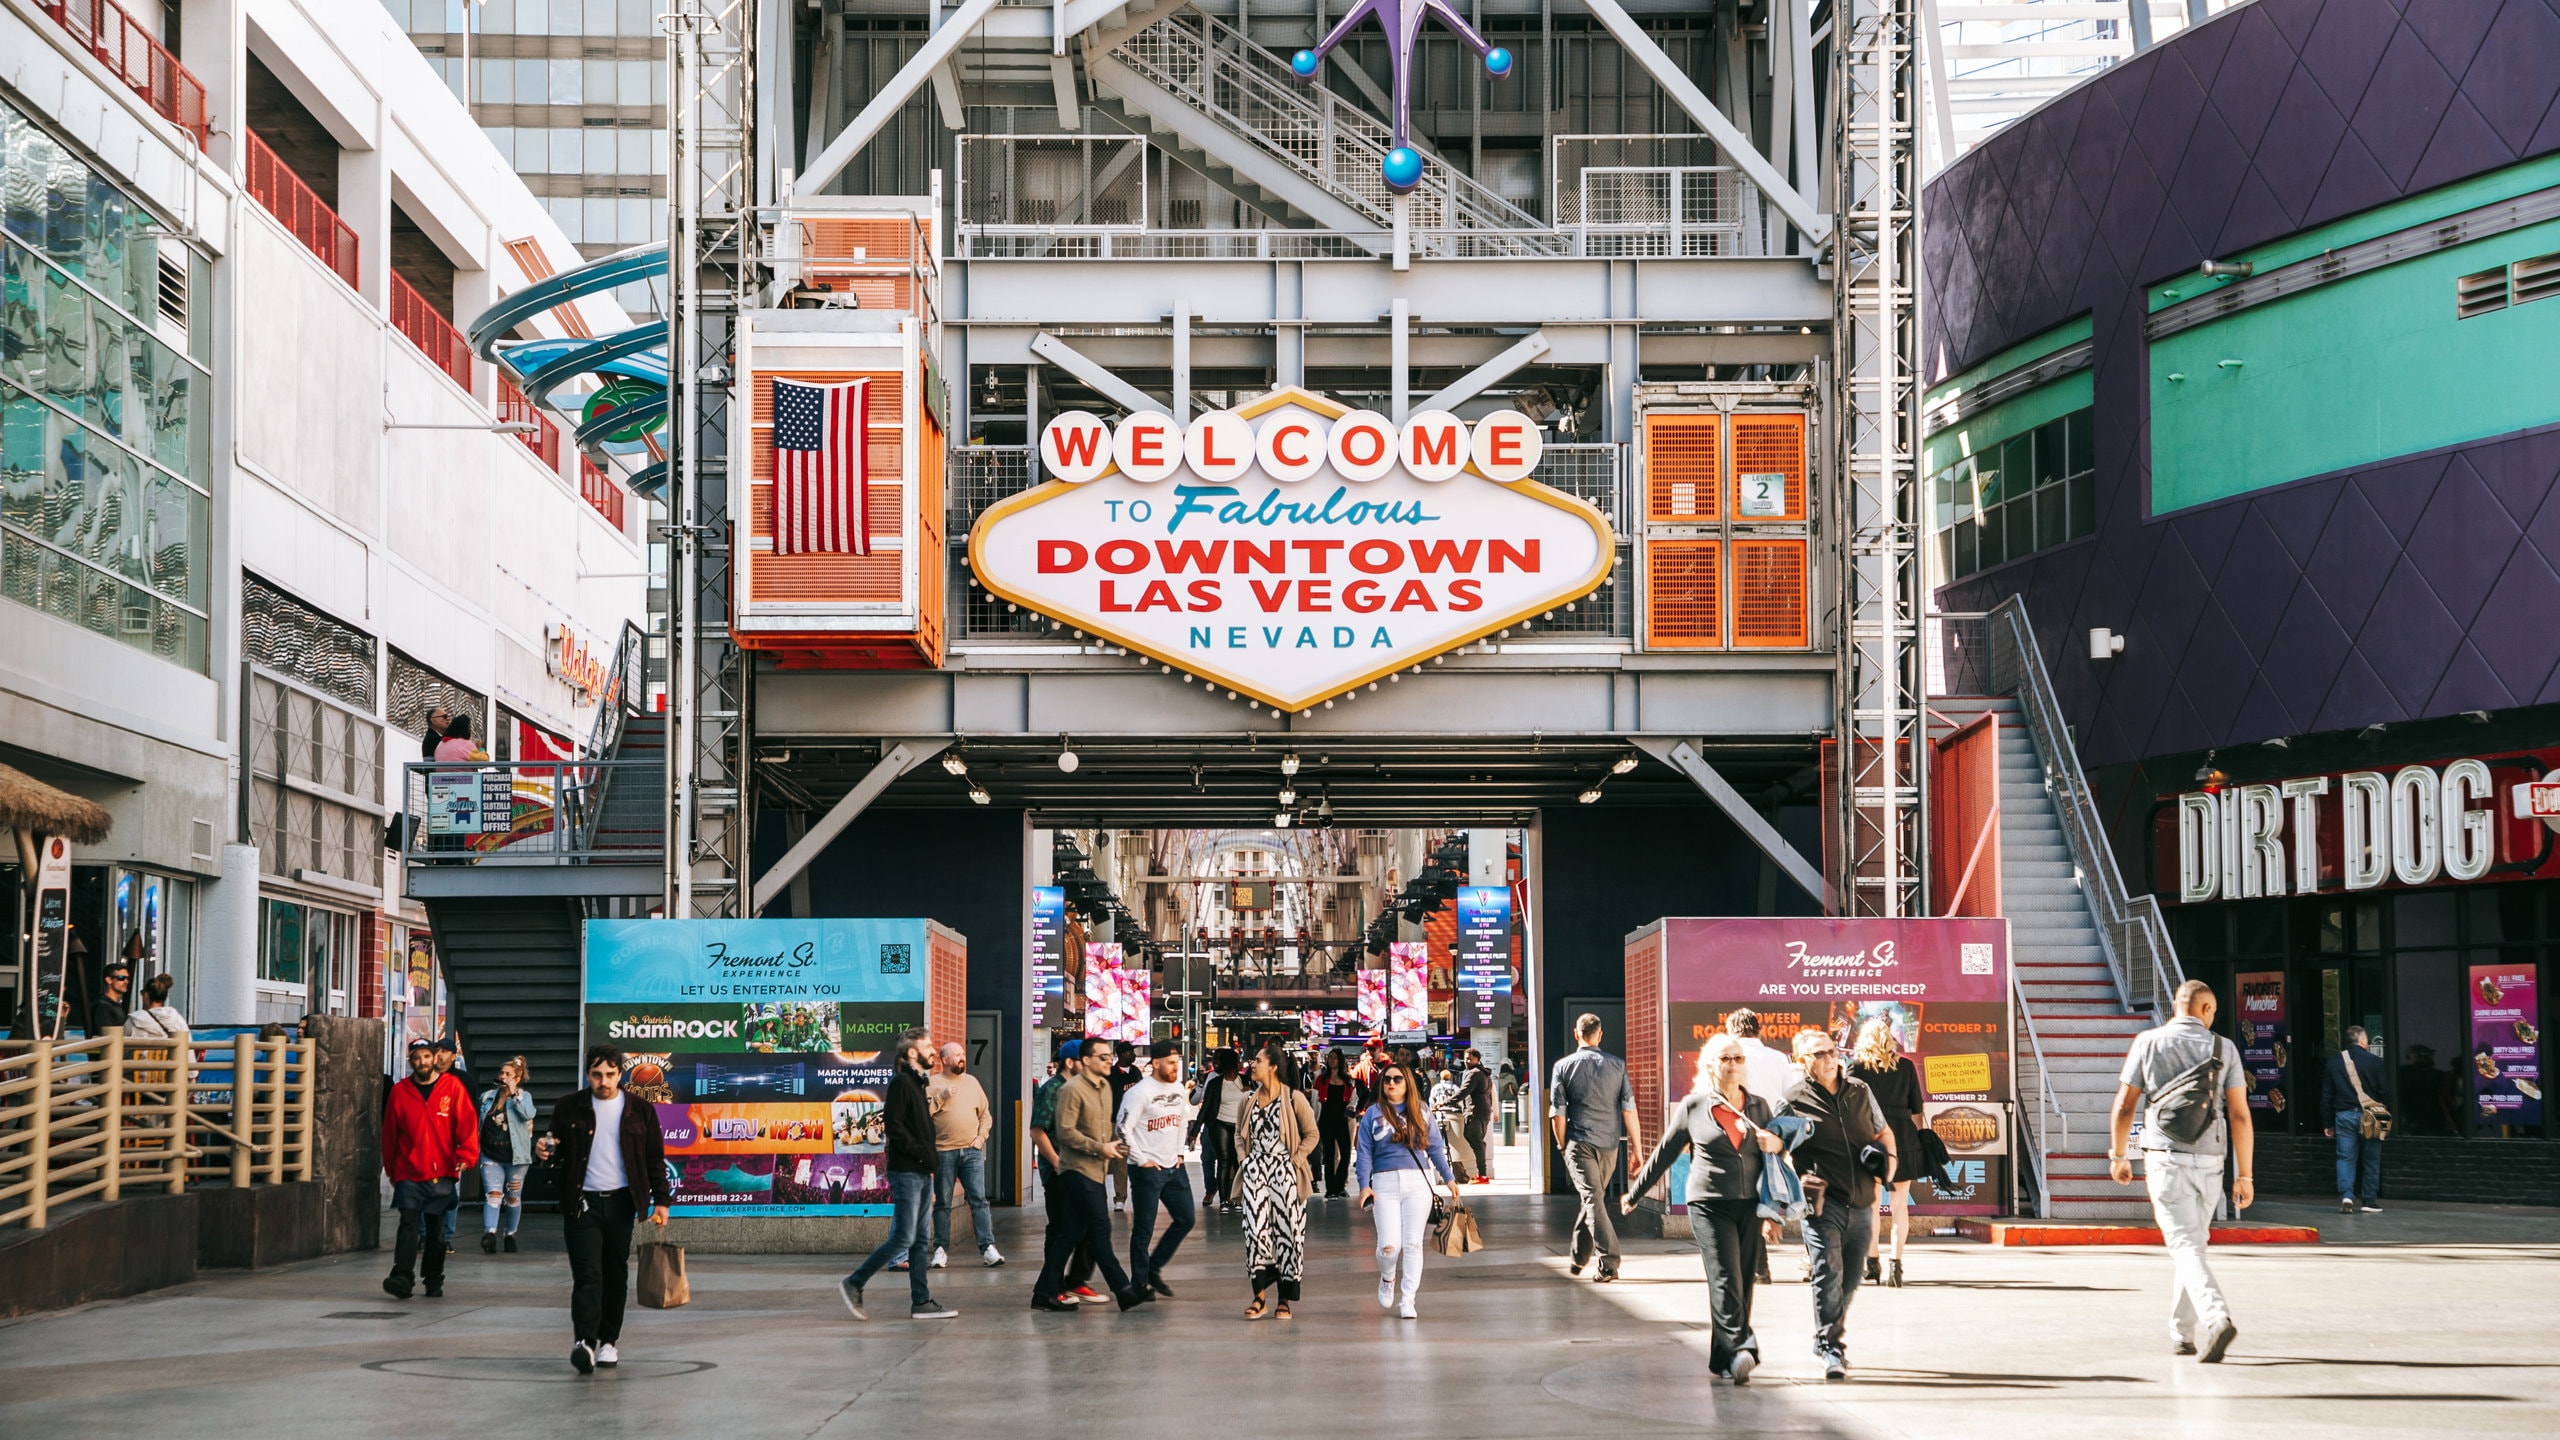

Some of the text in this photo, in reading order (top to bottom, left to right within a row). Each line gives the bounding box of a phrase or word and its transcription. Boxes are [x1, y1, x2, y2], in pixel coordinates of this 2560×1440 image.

[1051, 425, 1523, 467] WELCOME
[1757, 482, 1769, 499] 2
[1104, 484, 1441, 535] TO Fabulous
[1037, 539, 1541, 574] DOWNTOWN
[1099, 579, 1484, 613] LAS VEGAS
[1190, 626, 1393, 648] NEVADA
[482, 773, 511, 782] PURCHASE
[482, 783, 511, 791] TICKETS
[483, 793, 510, 801] IN THE
[482, 802, 510, 810] SLOTZILLA
[482, 812, 511, 821] TICKET
[482, 822, 511, 831] OFFICE
[2179, 758, 2495, 904] DIRT DOG
[706, 941, 816, 969] Fremont St.
[1785, 940, 1865, 969] Fremont
[1868, 940, 1899, 968] St.
[1803, 969, 1882, 977] EXPERIENCE
[681, 984, 841, 995] LET US ENTERTAIN YOU
[1759, 983, 1926, 995] ARE YOU EXPERIENCED?
[2242, 982, 2281, 996] FAVORITE
[2245, 995, 2278, 1011] Munchies
[629, 1015, 672, 1024] St. Patrick's
[608, 1020, 738, 1039] ShamROCK
[846, 1023, 911, 1034] MARCH 17
[1924, 1023, 1997, 1033] OCTOBER 31
[622, 1054, 674, 1072] DOWNTOWN
[1929, 1062, 1962, 1070] LOOKING
[817, 1069, 893, 1077] MARCH MADNESS
[824, 1077, 845, 1085] MAR
[846, 1077, 855, 1085] 14
[862, 1077, 881, 1085] APR
[882, 1077, 888, 1085] 3
[711, 1118, 824, 1142] LUAU WOW
[676, 1194, 727, 1202] SEPTEMBER
[710, 1206, 806, 1214] VEGASEXPERIENCE.COM
